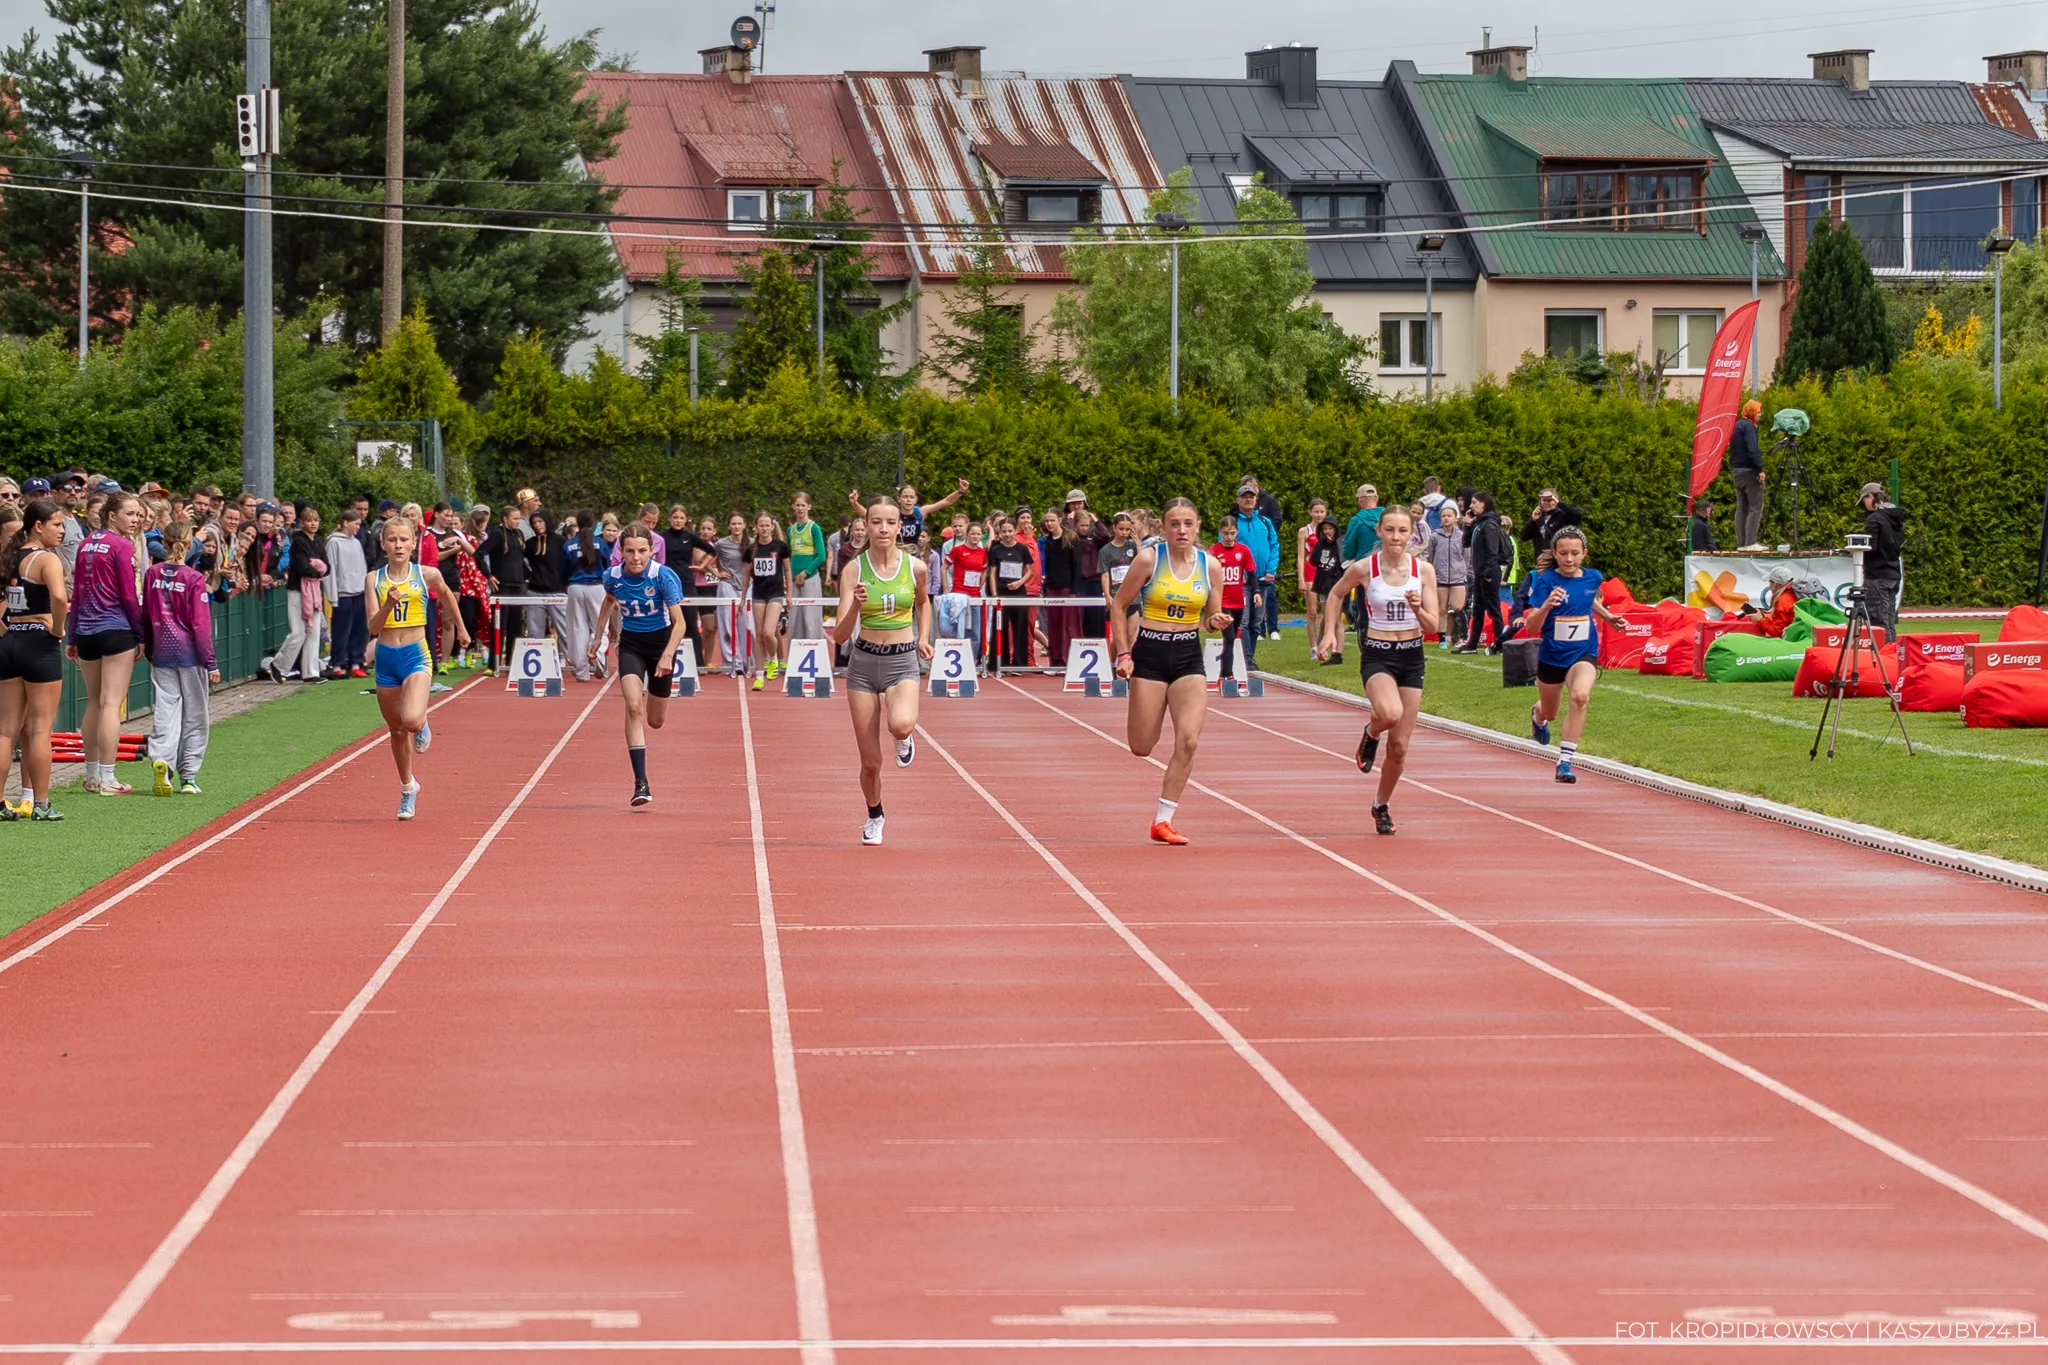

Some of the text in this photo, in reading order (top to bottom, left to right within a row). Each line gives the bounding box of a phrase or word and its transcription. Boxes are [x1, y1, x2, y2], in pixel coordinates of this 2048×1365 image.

[1714, 359, 1741, 369] Energa
[81, 543, 111, 554] AMS
[755, 560, 774, 572] 403
[152, 579, 186, 593] AMS
[393, 601, 409, 622] 67
[619, 599, 659, 617] 511
[880, 593, 896, 615] 11
[1166, 604, 1187, 619] 65
[1386, 601, 1406, 621] 90
[1140, 629, 1197, 641] NIKE PRO
[1568, 625, 1579, 640] 7
[862, 643, 891, 654] PRO
[896, 643, 915, 653] NIK
[1366, 639, 1421, 650] PRO NIKE
[522, 649, 542, 678] 6
[798, 649, 818, 678] 4
[943, 650, 963, 678] 3
[1079, 650, 1099, 679] 2
[1746, 656, 1772, 664] Energa
[2003, 654, 2042, 666] Energa
